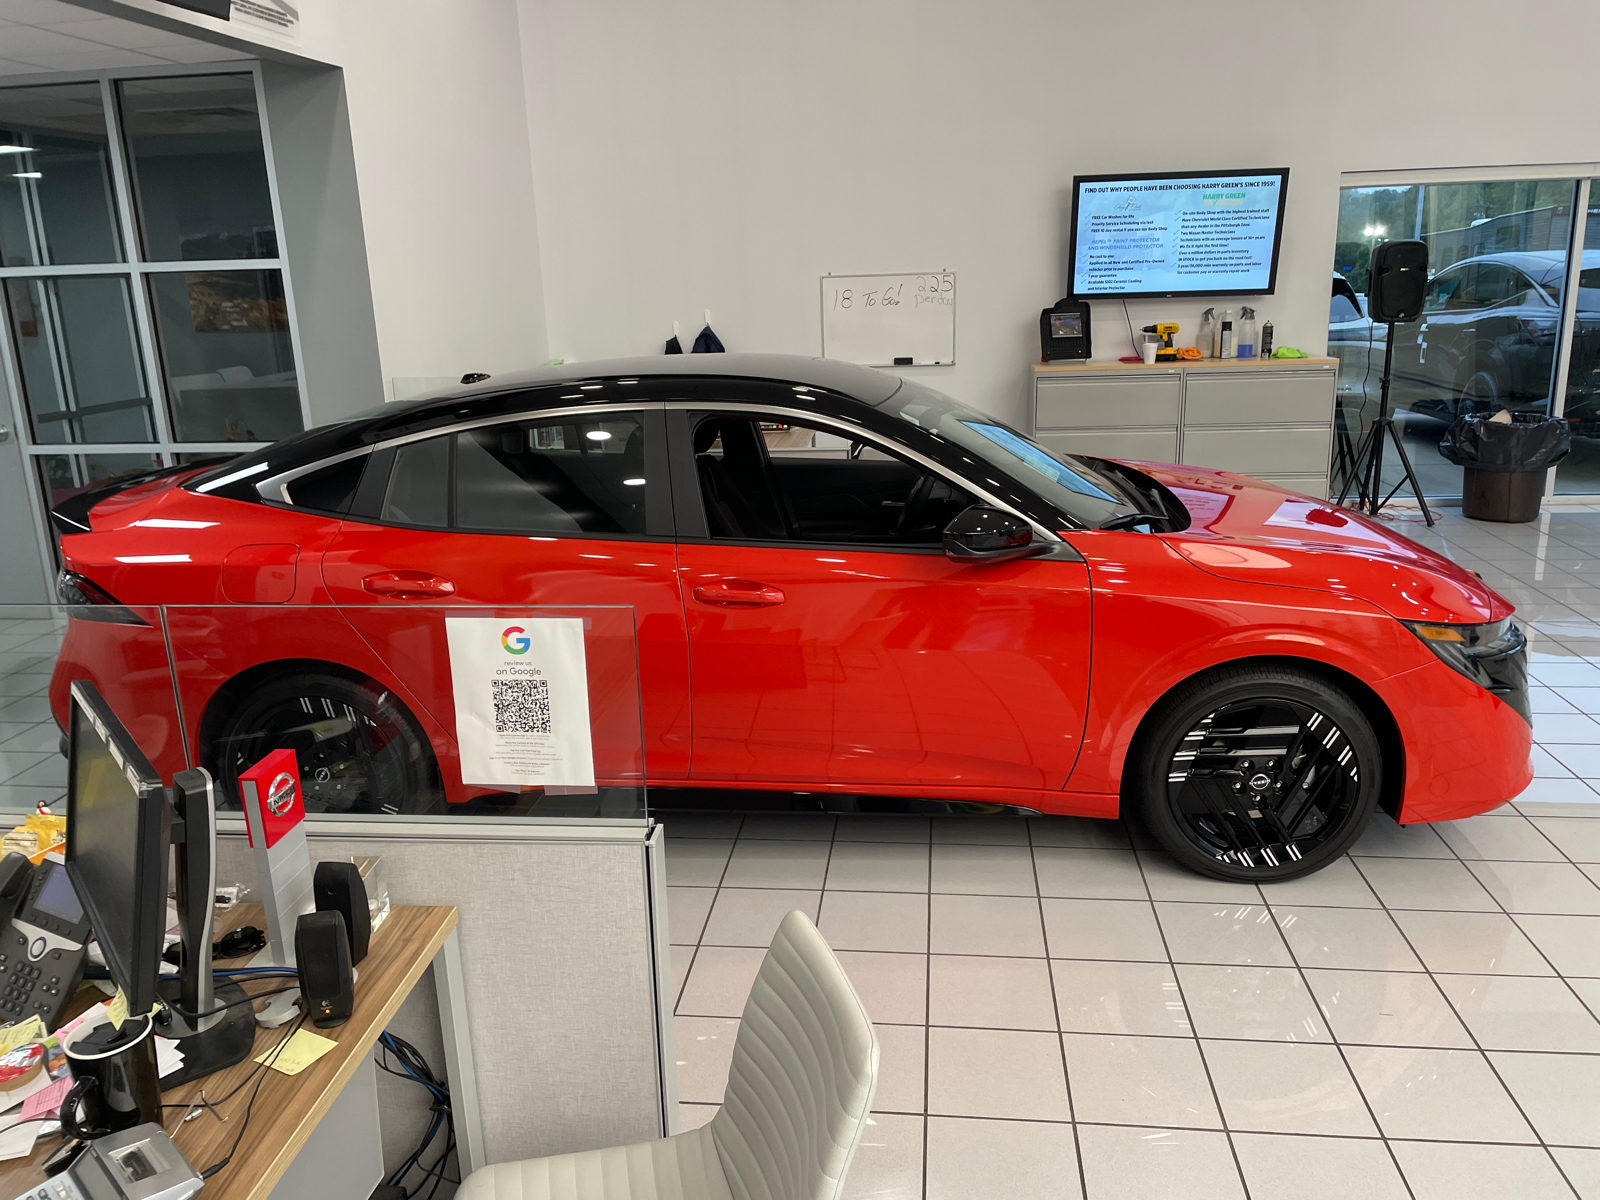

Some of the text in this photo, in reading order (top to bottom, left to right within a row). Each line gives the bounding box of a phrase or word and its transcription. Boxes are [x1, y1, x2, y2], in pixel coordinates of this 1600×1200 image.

[834, 289, 853, 311] 18
[863, 291, 878, 307] To
[509, 667, 541, 677] Google
